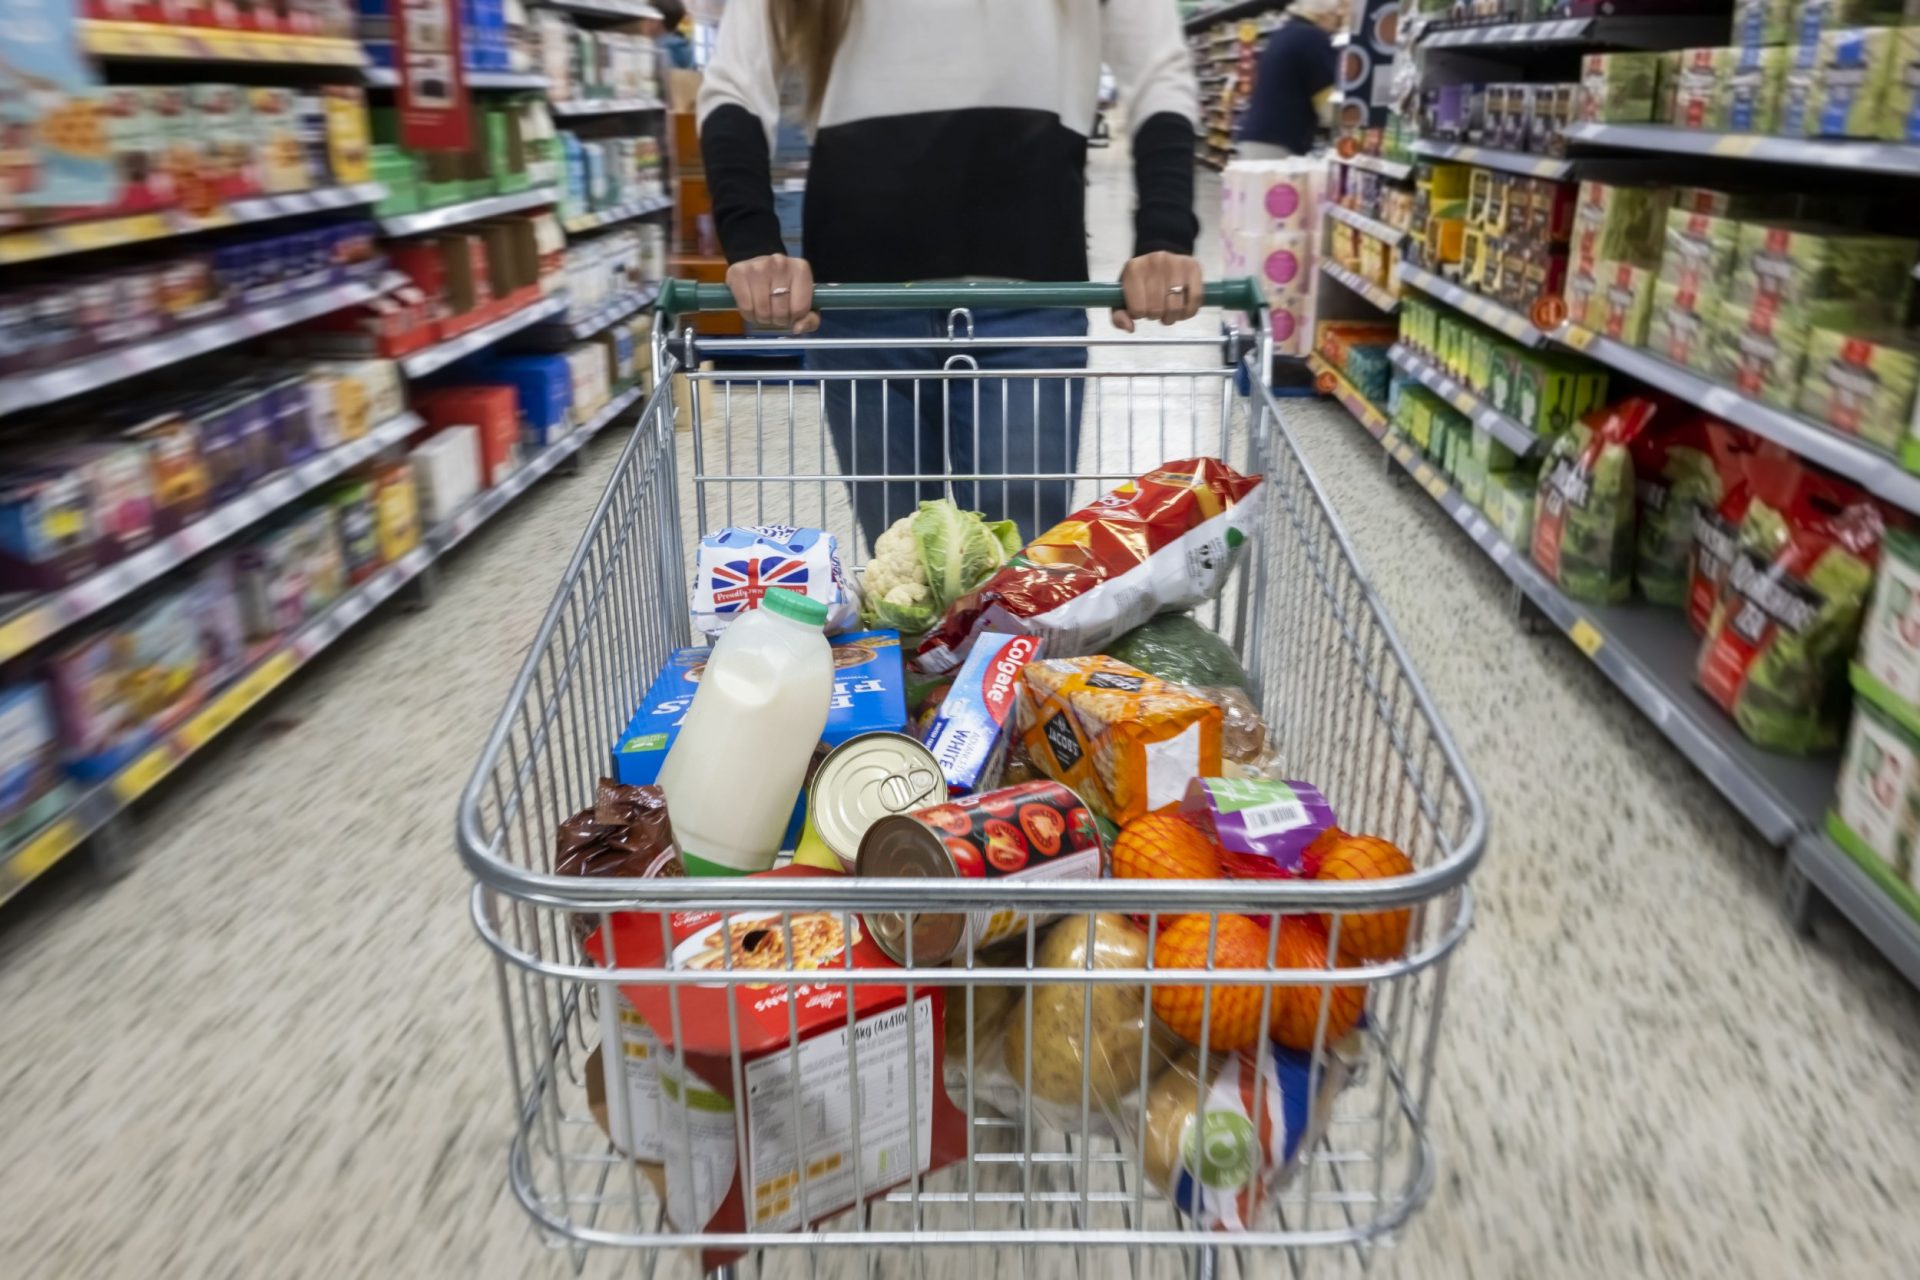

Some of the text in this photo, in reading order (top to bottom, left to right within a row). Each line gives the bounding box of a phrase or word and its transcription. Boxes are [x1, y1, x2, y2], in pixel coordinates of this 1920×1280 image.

[717, 587, 748, 601] Proudly
[986, 638, 1033, 704] Colgate
[940, 730, 971, 770] WHITE
